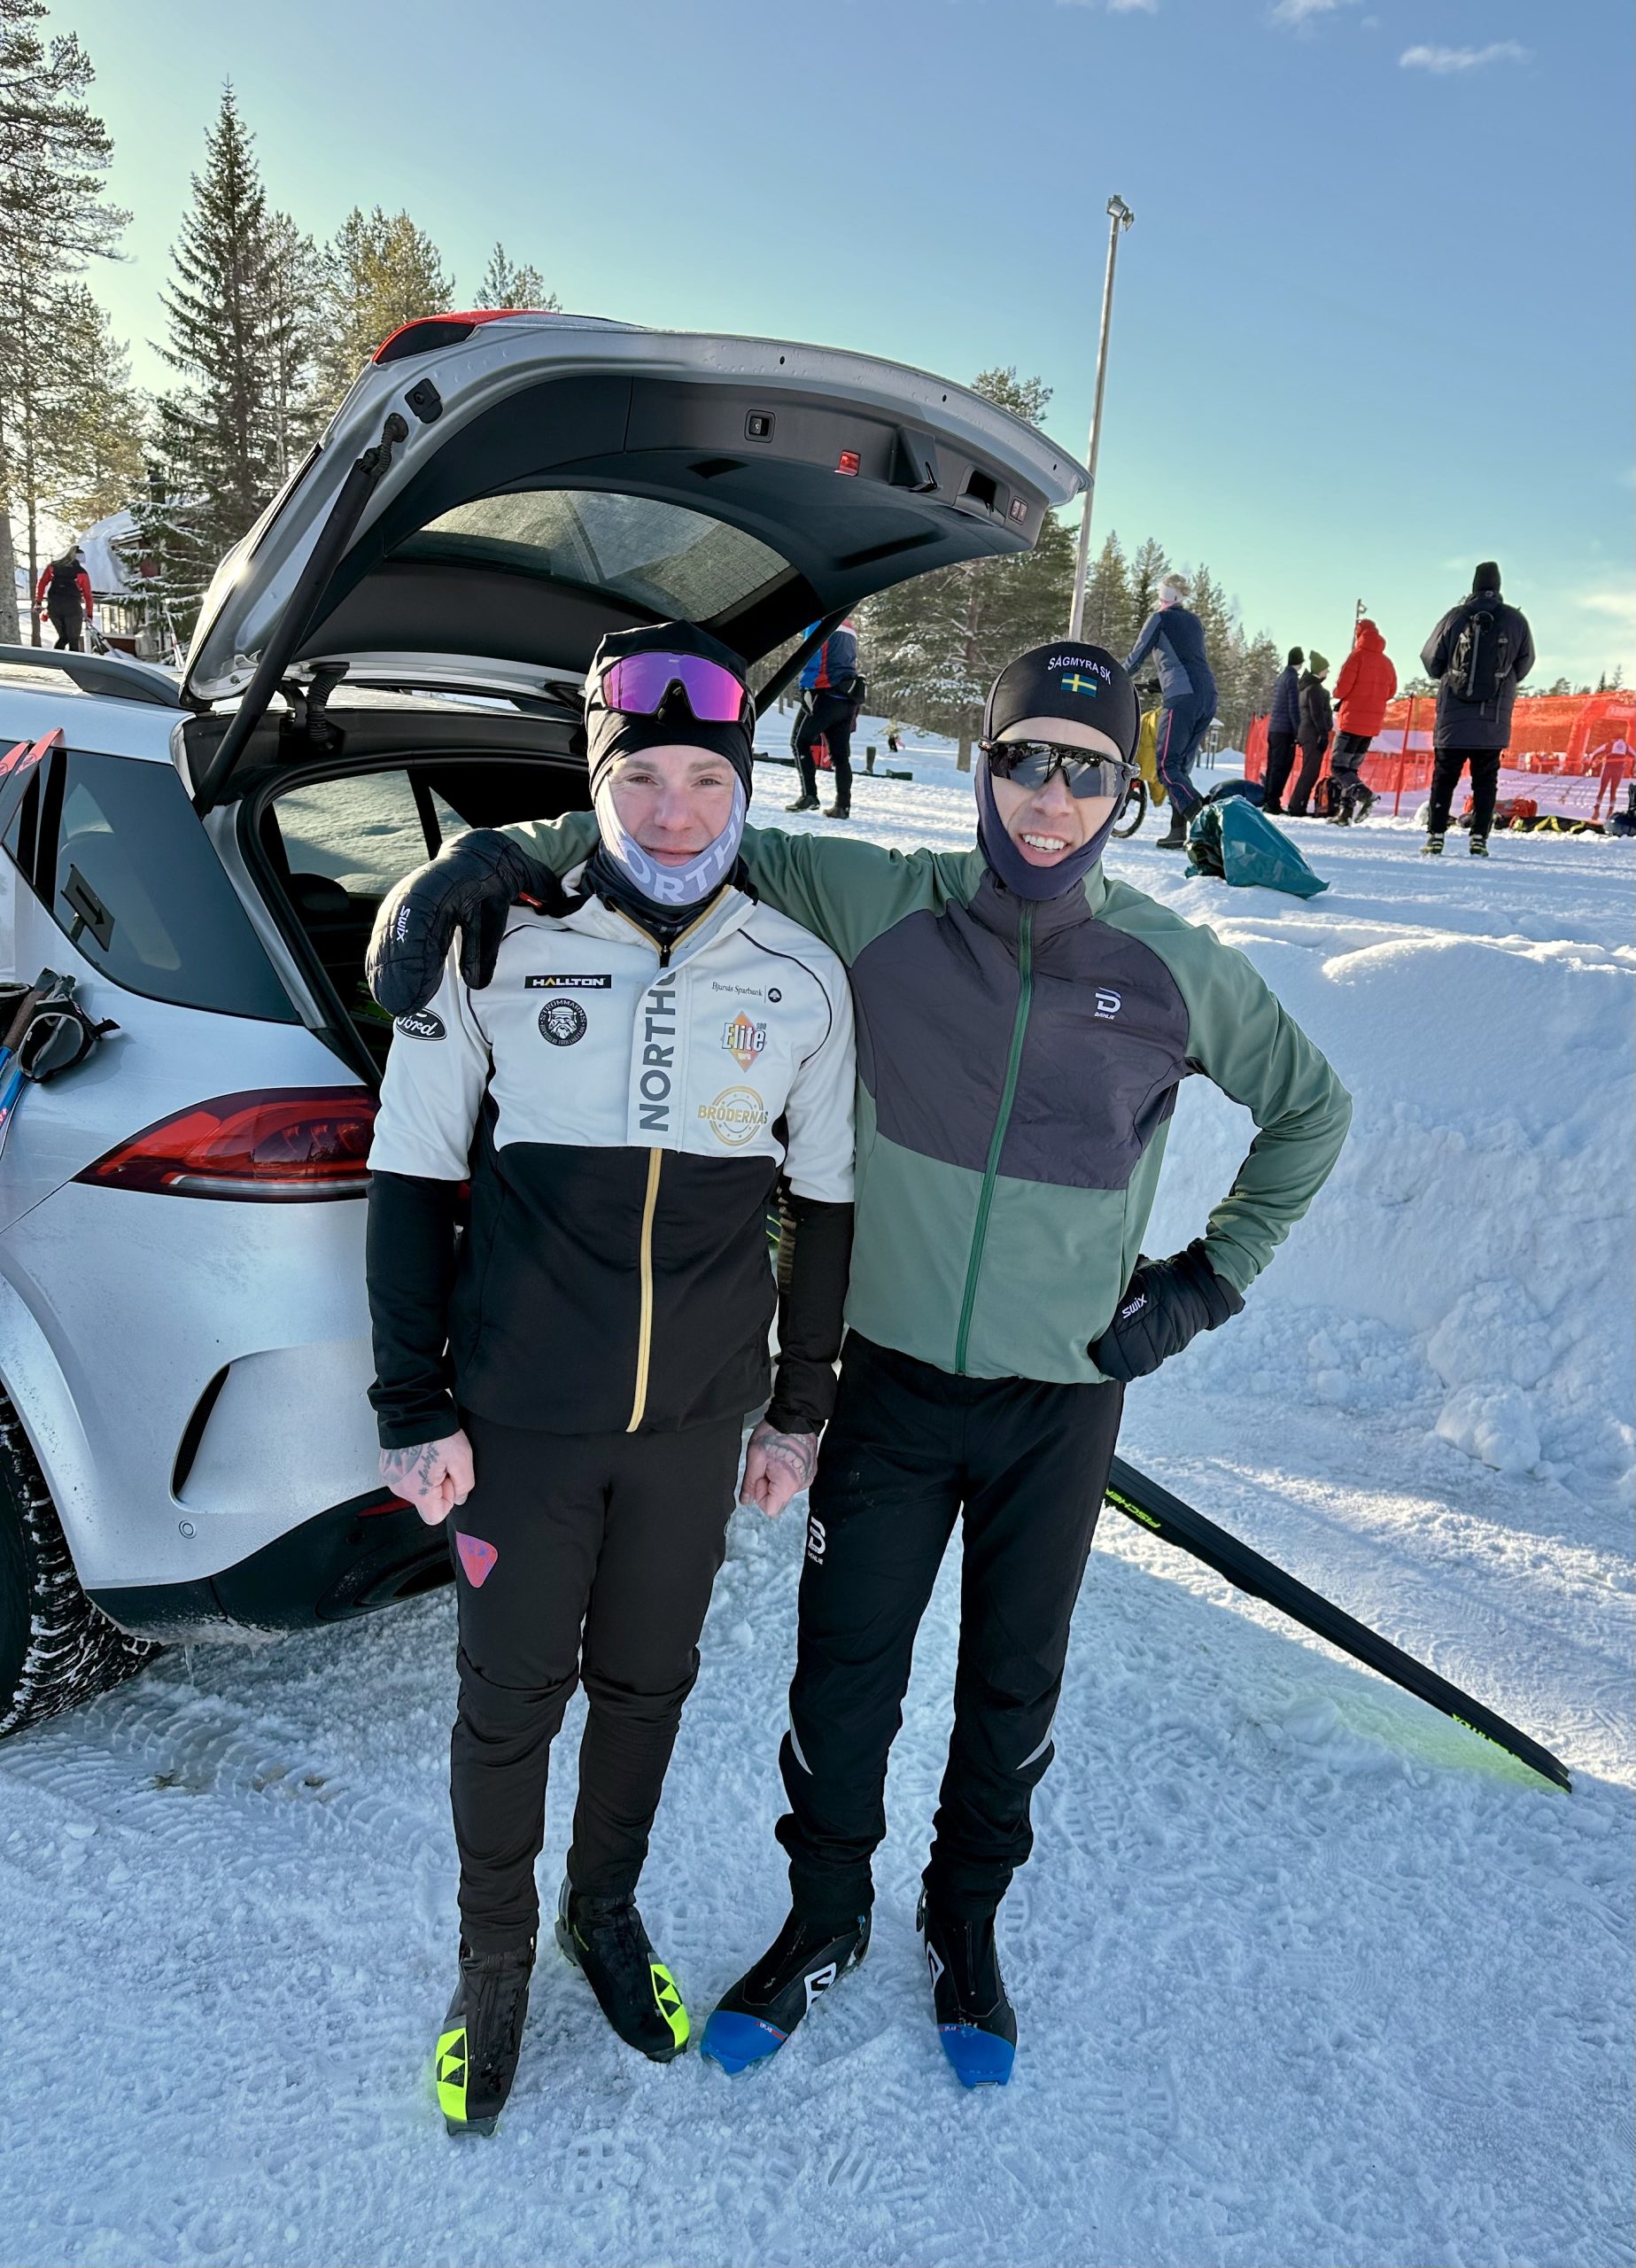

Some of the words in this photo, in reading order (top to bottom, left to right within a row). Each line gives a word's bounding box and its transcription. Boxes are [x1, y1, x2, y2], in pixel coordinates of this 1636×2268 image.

[1048, 655, 1099, 673] SÅGMYRA
[1099, 666, 1112, 686] SK
[532, 977, 604, 986] HALLTON
[721, 1021, 766, 1052] Elite
